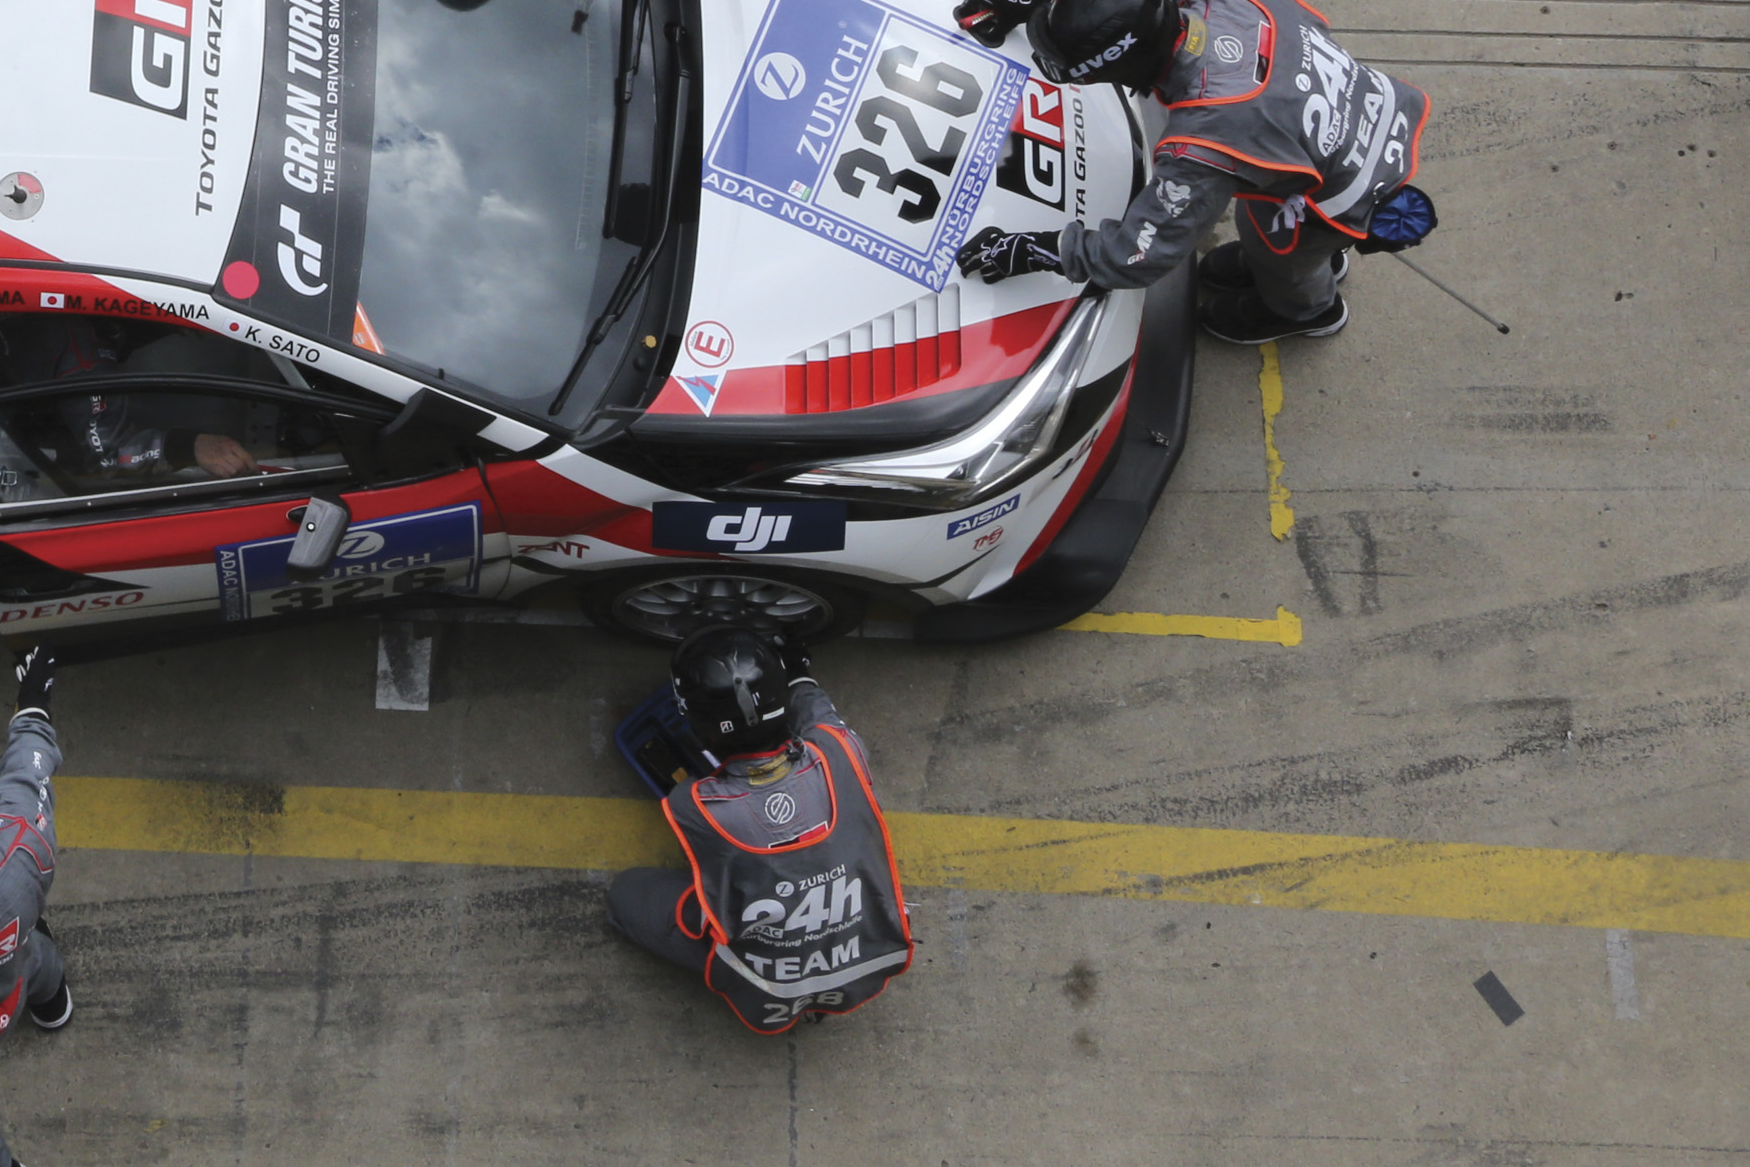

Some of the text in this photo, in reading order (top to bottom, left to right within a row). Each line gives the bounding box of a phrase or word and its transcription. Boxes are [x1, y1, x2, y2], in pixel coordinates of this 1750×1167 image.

[327, 34, 340, 106] DRIVING
[1068, 32, 1138, 79] uvex
[1299, 24, 1311, 71] ZURICH
[795, 34, 870, 166] ZURICH
[195, 87, 220, 217] TOYOTA
[282, 83, 322, 194] GRAN
[325, 108, 339, 156] REAL
[833, 44, 984, 225] 326
[1023, 80, 1063, 205] GR
[1074, 97, 1086, 182] GAZOO
[1323, 108, 1342, 156] ADAC
[323, 161, 337, 195] THE
[925, 67, 1018, 292] 24h NÜRBURGRING
[952, 71, 1028, 250] NORDSCHLEIFE
[702, 172, 928, 280] ADAC NORDRHEIN
[65, 294, 211, 321] M. KAGEYAMA
[245, 325, 322, 363] K. SATO
[953, 498, 1016, 535] AISIN
[219, 550, 237, 586] ADAC
[270, 566, 447, 615] 326
[296, 553, 431, 582] URICH
[0, 591, 145, 624] DENSO
[799, 864, 847, 892] ZURICH
[740, 875, 863, 937] 24h
[745, 935, 861, 981] TEAM
[763, 991, 845, 1024] 268
